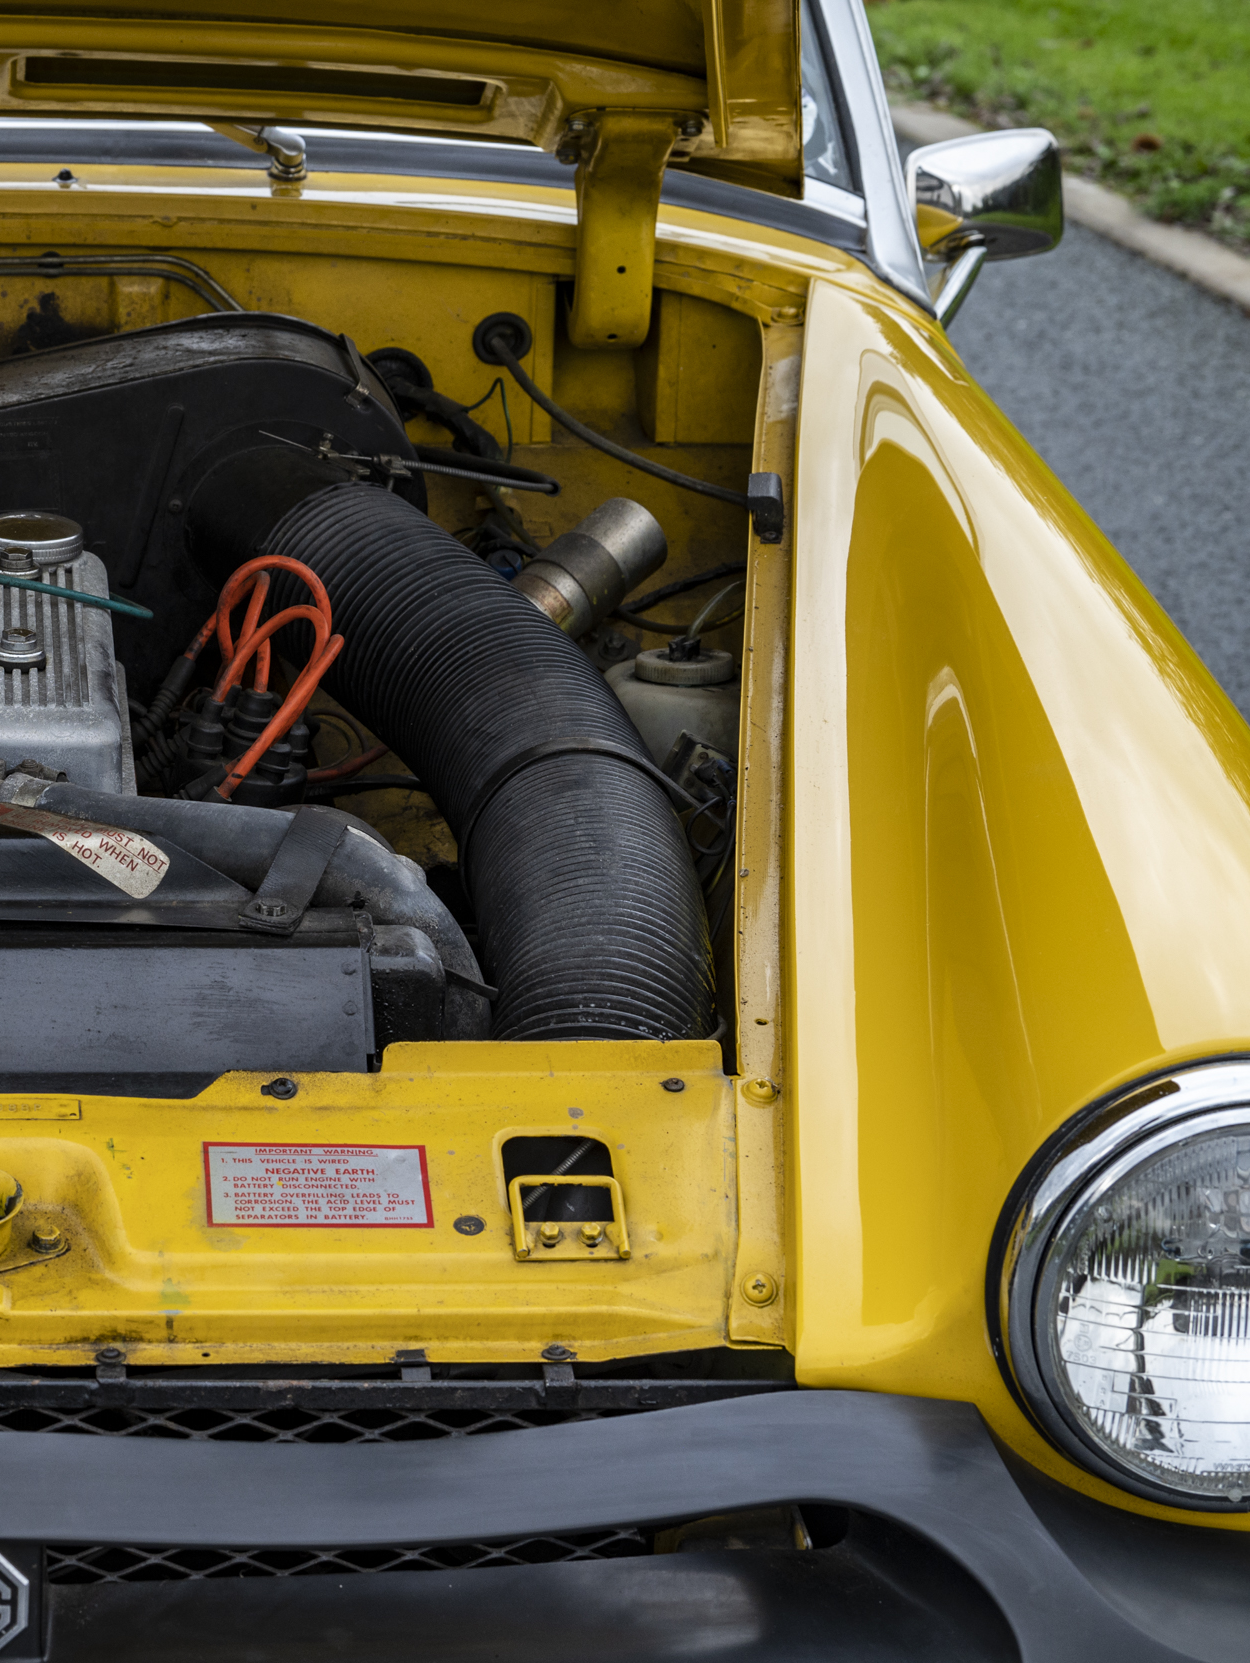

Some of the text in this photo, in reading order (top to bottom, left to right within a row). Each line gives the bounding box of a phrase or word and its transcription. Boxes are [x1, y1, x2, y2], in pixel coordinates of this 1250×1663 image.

[34, 818, 93, 839] REMOVED
[99, 838, 139, 871] WHEN
[52, 831, 68, 842] IS
[72, 841, 103, 868] HOT.
[95, 825, 134, 847] MUST
[138, 847, 167, 871] NOT
